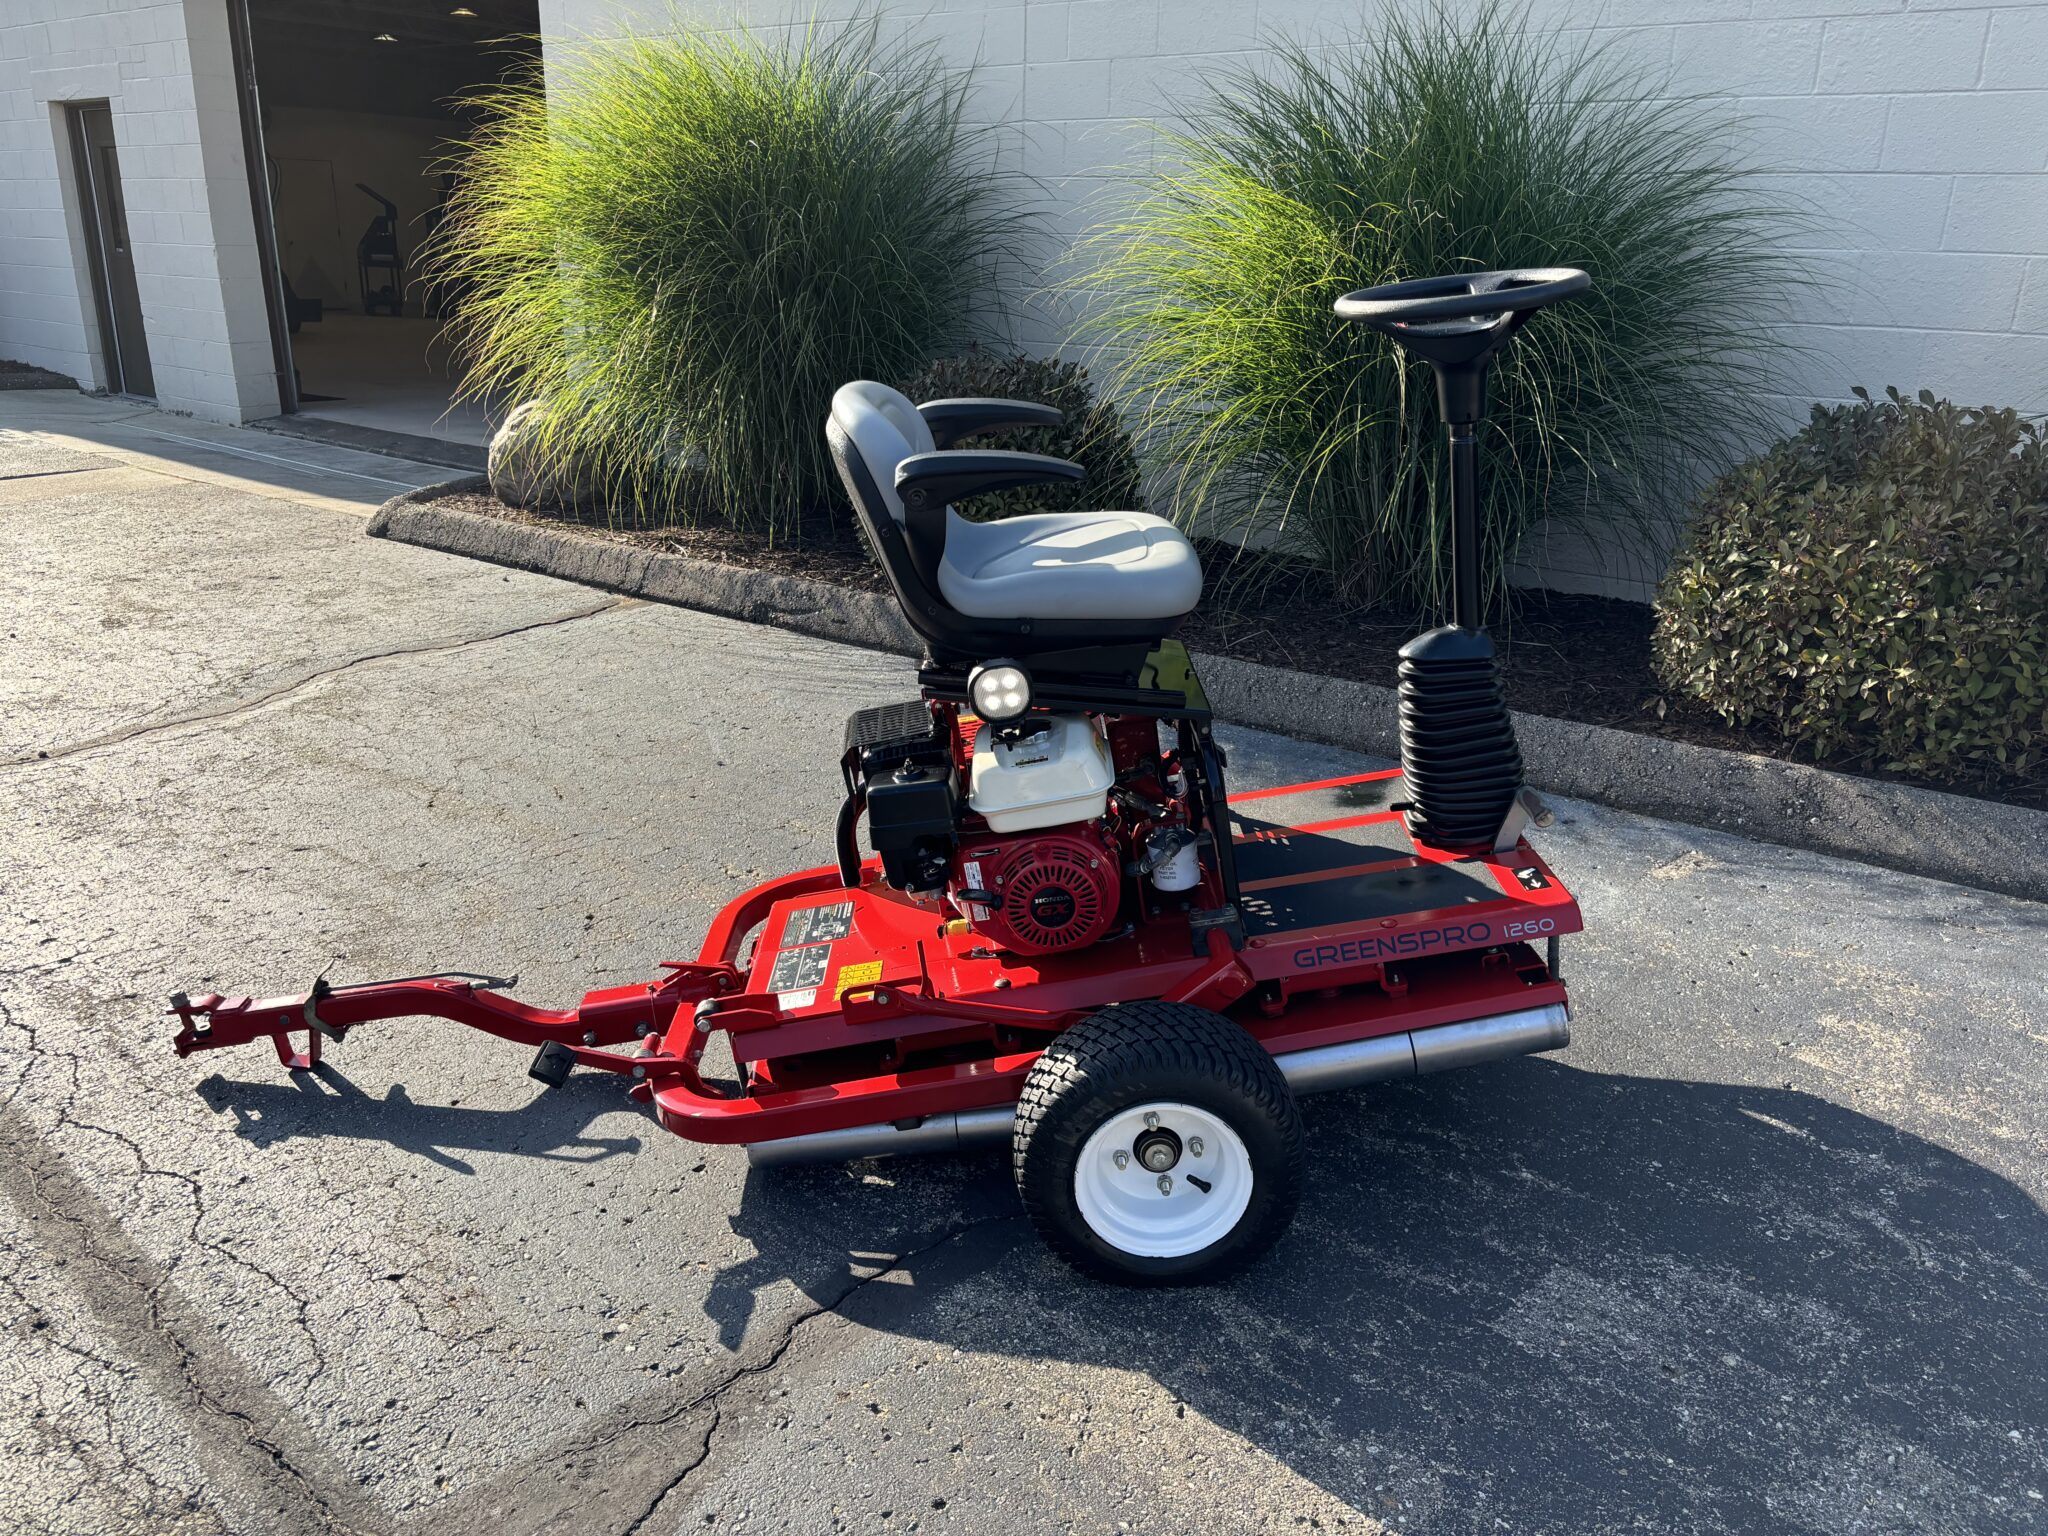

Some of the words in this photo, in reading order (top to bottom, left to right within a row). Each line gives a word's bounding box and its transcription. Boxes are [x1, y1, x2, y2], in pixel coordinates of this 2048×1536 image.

[1034, 895, 1071, 904] HONDA
[1037, 902, 1070, 917] GX
[1293, 922, 1492, 969] GREENSPRO
[1503, 918, 1556, 939] 1260
